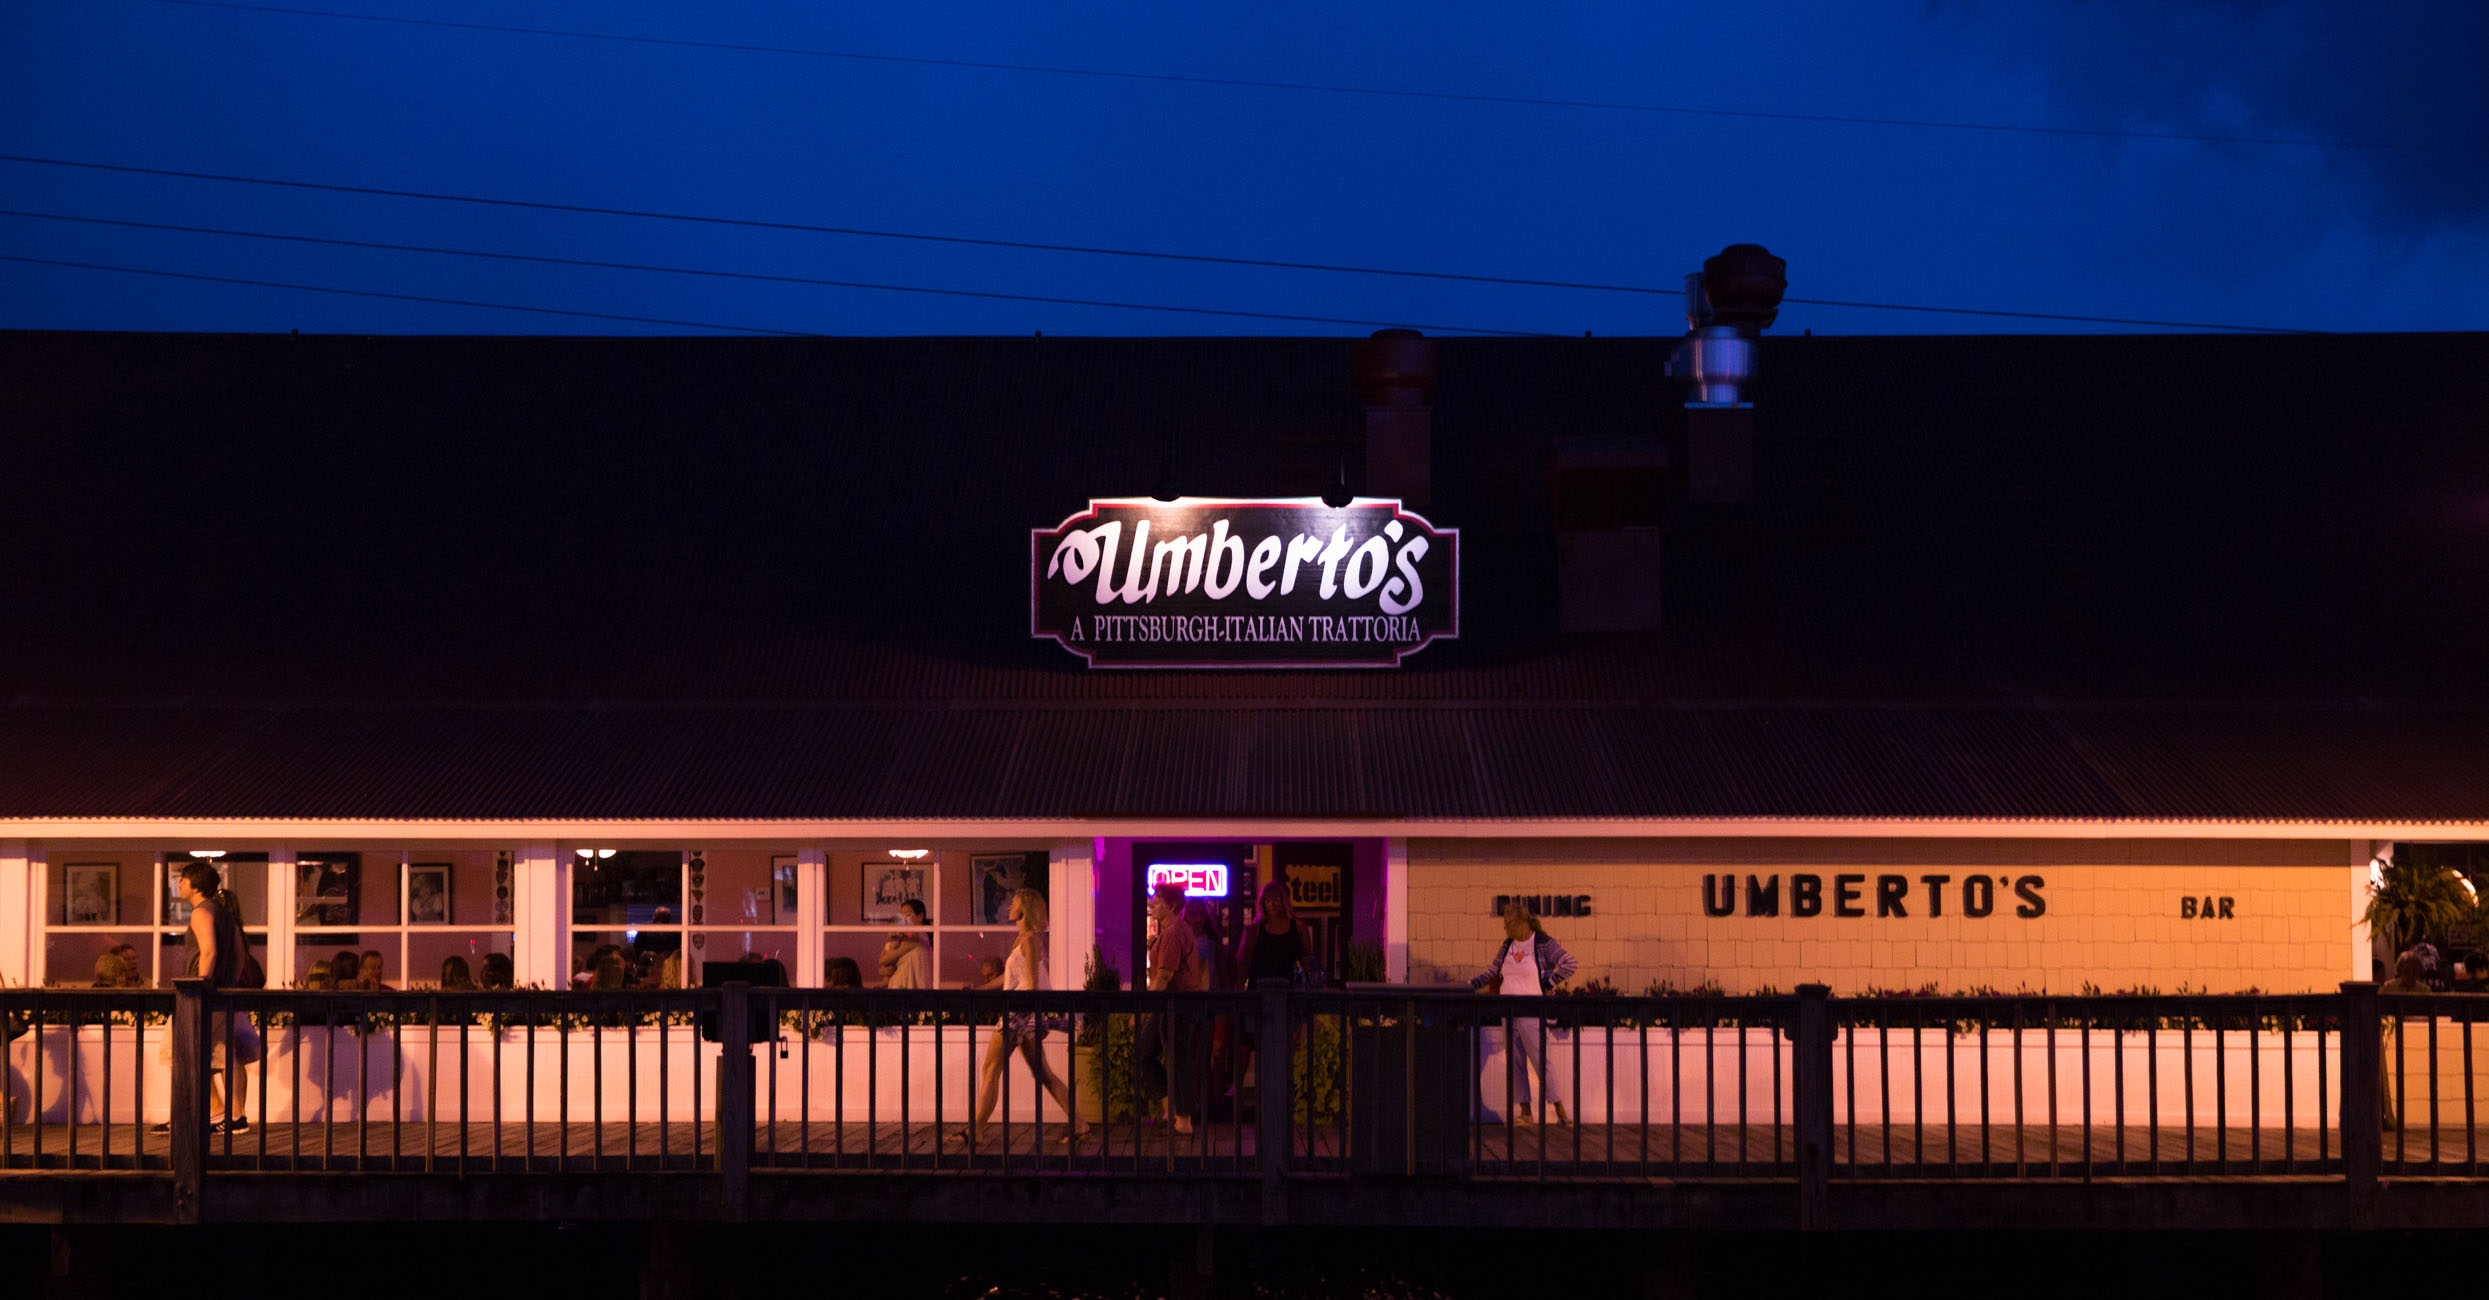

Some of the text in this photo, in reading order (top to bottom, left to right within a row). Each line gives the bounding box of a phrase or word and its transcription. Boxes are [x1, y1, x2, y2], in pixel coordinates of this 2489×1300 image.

[1047, 518, 1429, 616] Umberto's
[1070, 615, 1422, 643] A PITTSBURGH-ITALIAN TRATTORIA
[1152, 867, 1222, 892] OPEN
[1704, 873, 2046, 918] UMBERTO'S
[2181, 896, 2235, 919] BAR
